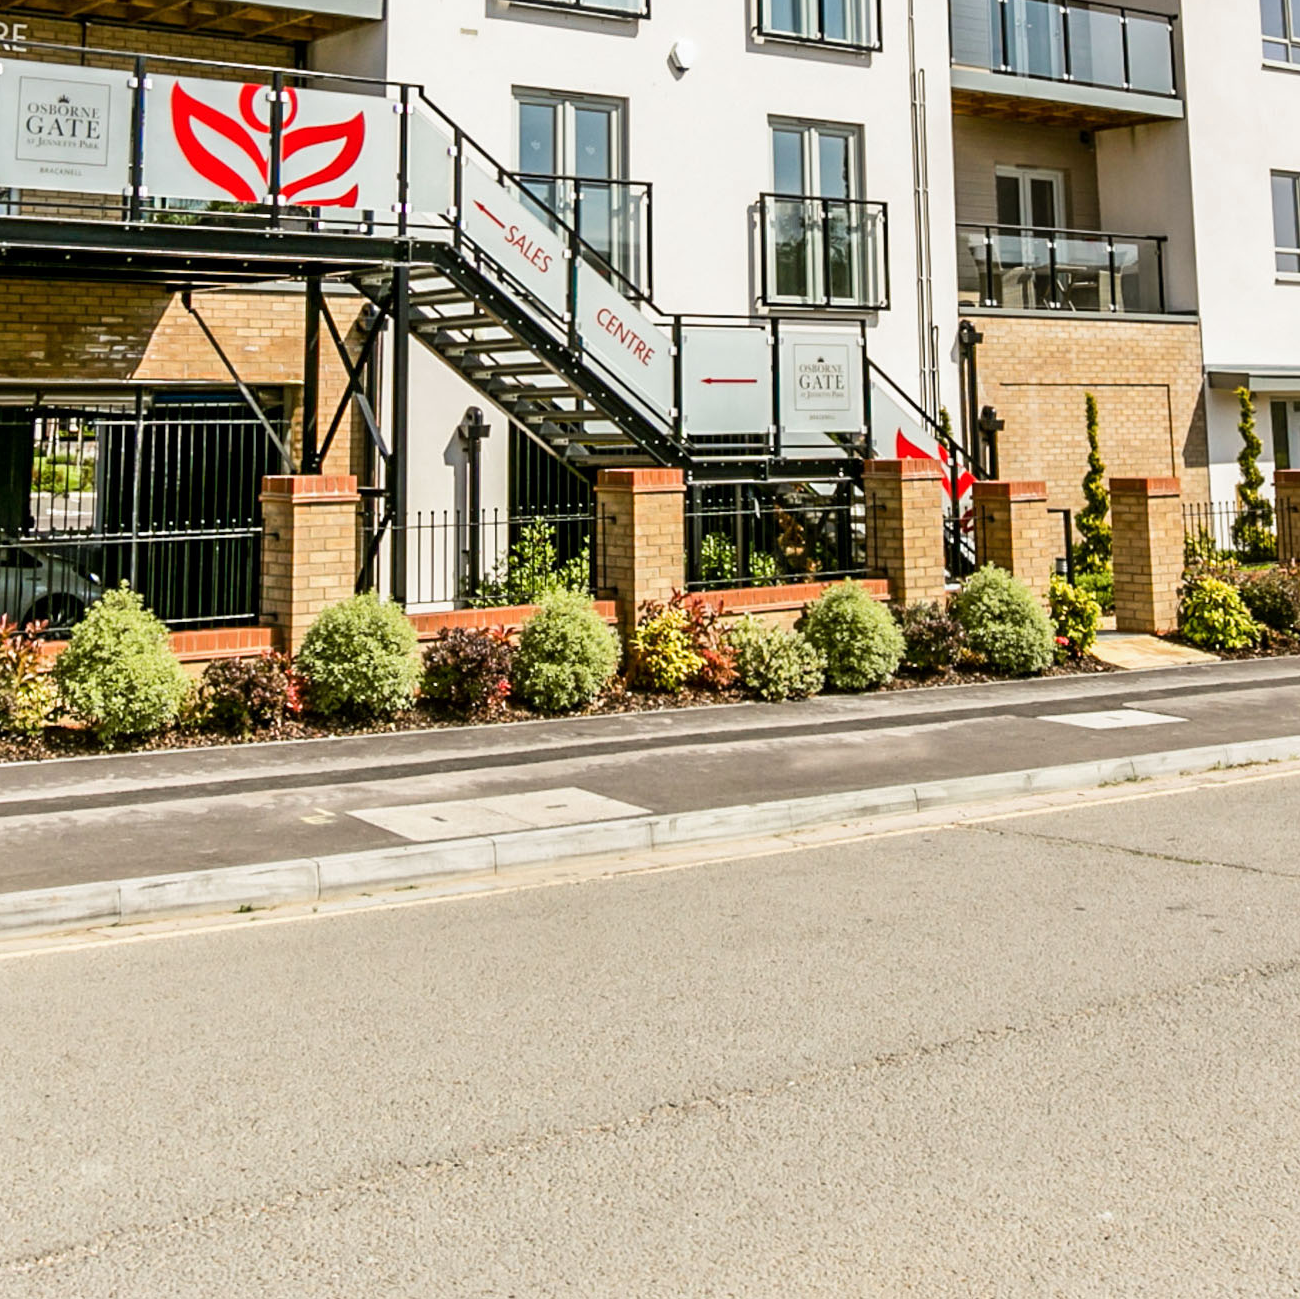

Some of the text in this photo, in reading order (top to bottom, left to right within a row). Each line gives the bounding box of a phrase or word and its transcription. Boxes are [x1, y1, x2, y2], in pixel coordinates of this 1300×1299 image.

[27, 102, 101, 119] OSBORNE
[26, 115, 101, 140] GATE
[504, 225, 553, 273] SALES
[596, 308, 655, 367] CENTRE
[799, 364, 844, 373] OSBORNE
[799, 374, 845, 390] GATE
